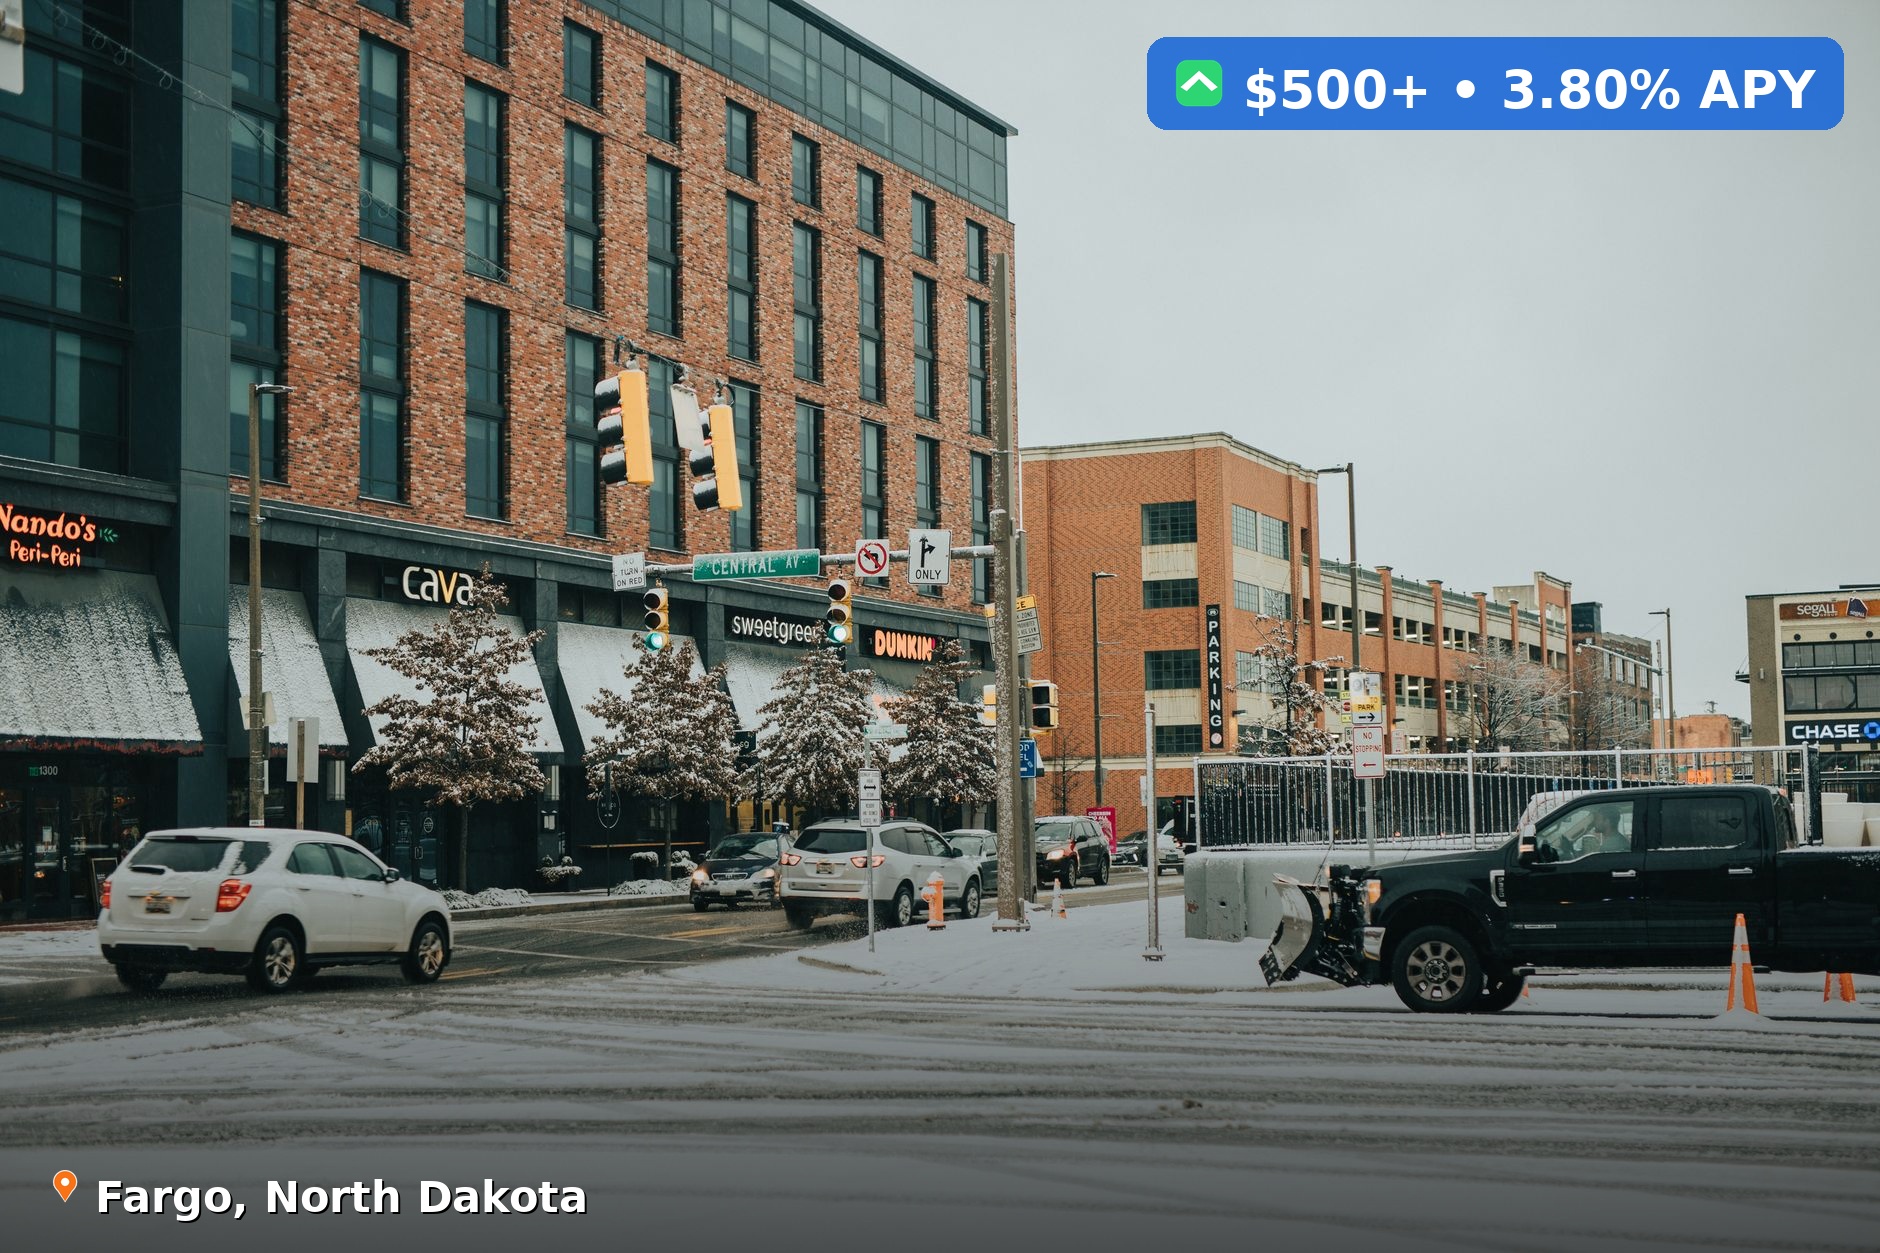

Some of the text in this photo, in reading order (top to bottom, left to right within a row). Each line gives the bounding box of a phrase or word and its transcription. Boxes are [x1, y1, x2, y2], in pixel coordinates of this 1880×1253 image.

[0, 503, 96, 542] Nando's
[10, 539, 81, 567] Peri-Peri
[620, 567, 639, 576] TURN
[712, 557, 776, 575] CENTRAL
[915, 569, 942, 580] ONLY
[616, 576, 643, 587] ON RED
[1208, 620, 1222, 727] PARKING
[1363, 732, 1373, 740] NO
[1792, 724, 1860, 739] CHASE
[1355, 743, 1382, 753] STOPPING
[39, 765, 59, 776] 1300
